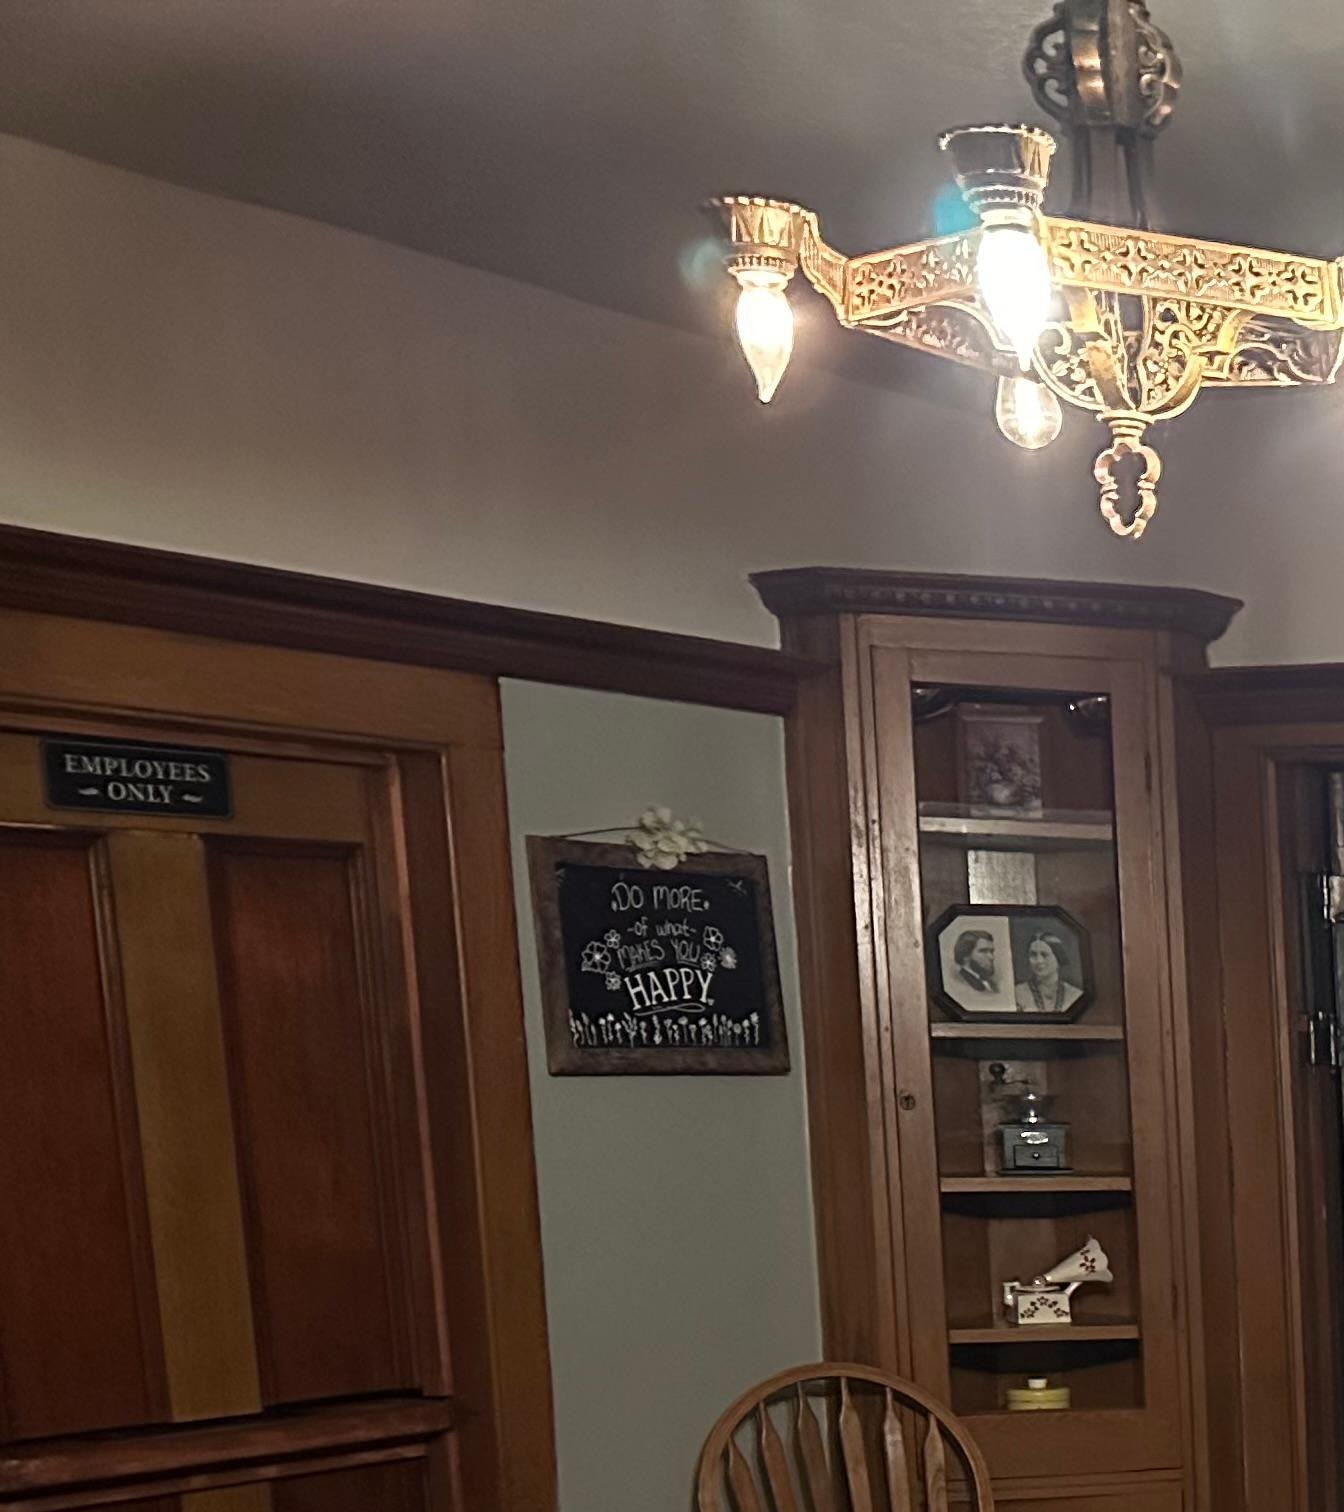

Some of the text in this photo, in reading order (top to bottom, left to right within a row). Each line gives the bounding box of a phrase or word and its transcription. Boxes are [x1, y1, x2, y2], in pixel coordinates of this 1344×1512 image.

[64, 754, 211, 782] EMPLOYEES
[107, 781, 173, 803] ONLY
[612, 882, 644, 911] DO
[670, 939, 701, 962] YOU
[624, 968, 713, 1010] HAPPY
